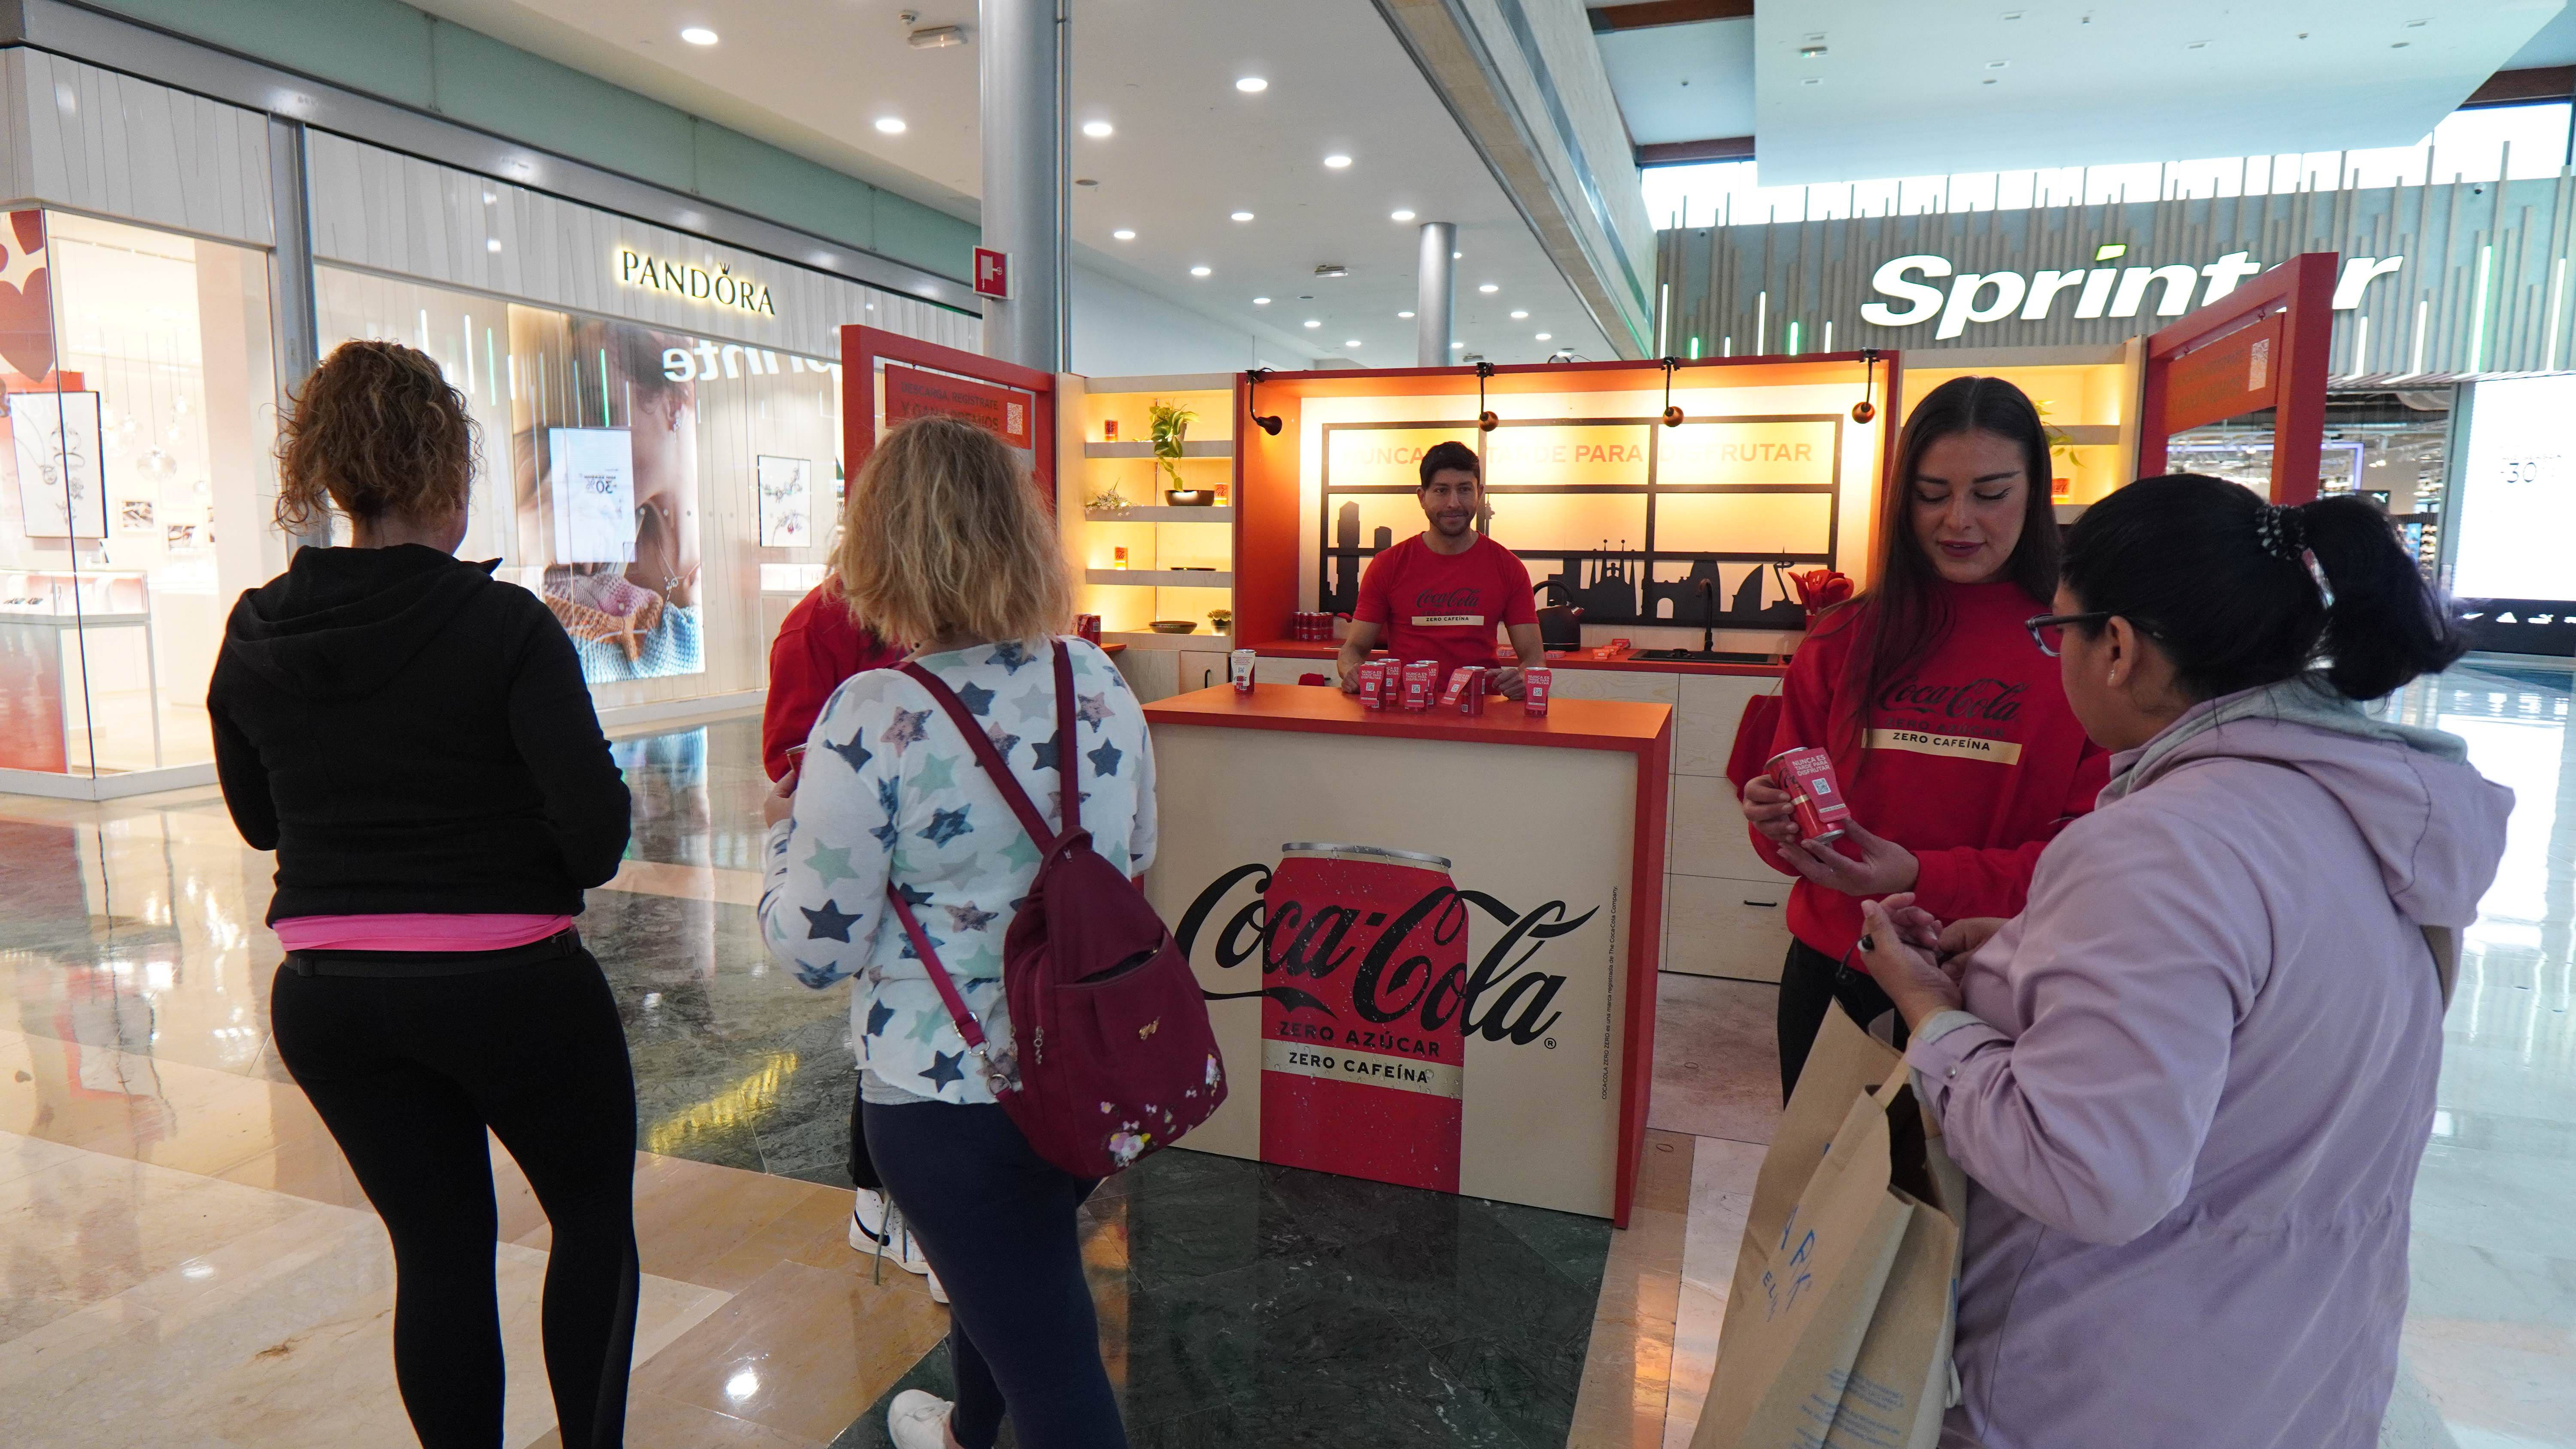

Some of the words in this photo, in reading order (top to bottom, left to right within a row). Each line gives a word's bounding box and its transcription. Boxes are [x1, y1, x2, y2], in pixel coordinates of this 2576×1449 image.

[623, 251, 776, 315] PANDORA
[1860, 244, 2404, 340] Sprintr
[1575, 444, 1643, 463] PARA
[1416, 587, 1482, 608] Coca-Cola
[1877, 675, 2034, 722] Coca-Cola
[1885, 717, 1929, 731] ZERO
[1893, 732, 1928, 743] ZERO
[1933, 738, 1990, 751] CAFEÍNA
[1792, 756, 1817, 767] NUNCA
[1797, 764, 1831, 776] DISFRUTAR
[1173, 863, 1600, 1046] Coca-Cola
[1279, 1021, 1334, 1041] ZERO
[1345, 1030, 1440, 1057] AZÚCAR
[1289, 1052, 1335, 1069] ZERO
[1343, 1059, 1428, 1084] CAFEÍNA
